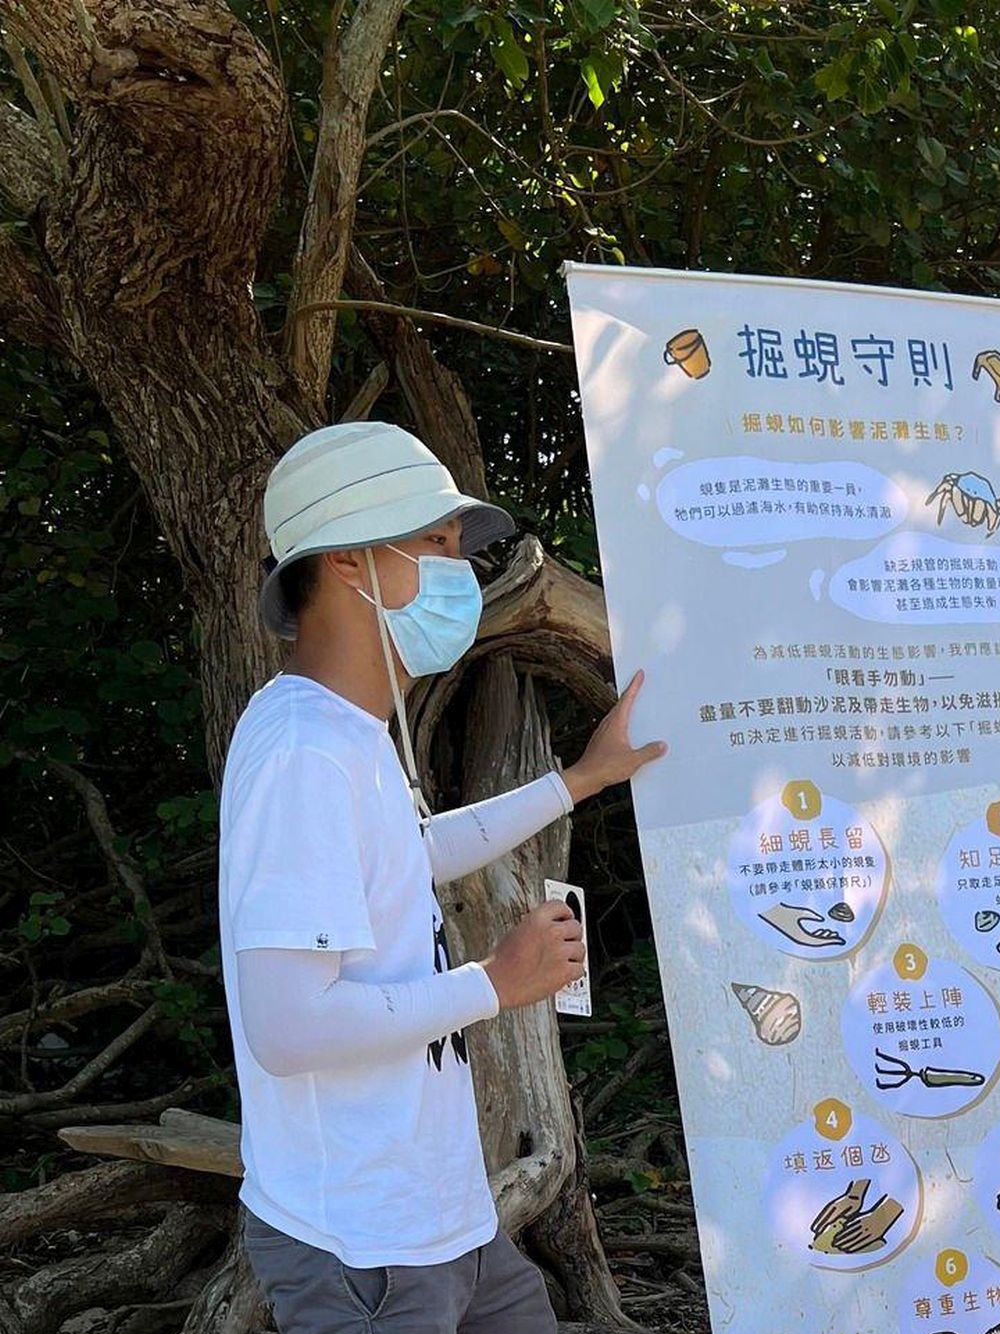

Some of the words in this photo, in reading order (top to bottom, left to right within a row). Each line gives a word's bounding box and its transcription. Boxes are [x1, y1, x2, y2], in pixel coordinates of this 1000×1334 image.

[737, 324, 953, 391] 掘蜆守則
[797, 791, 808, 811] 1
[760, 827, 863, 855] 細蜆長留
[904, 953, 917, 971] 3
[867, 986, 962, 1015] 輕裝上陣
[872, 1016, 964, 1035] 使用破壞性較低的
[898, 1037, 943, 1052] 掘蜆工具
[825, 1110, 839, 1129] 4
[945, 1257, 957, 1275] 6
